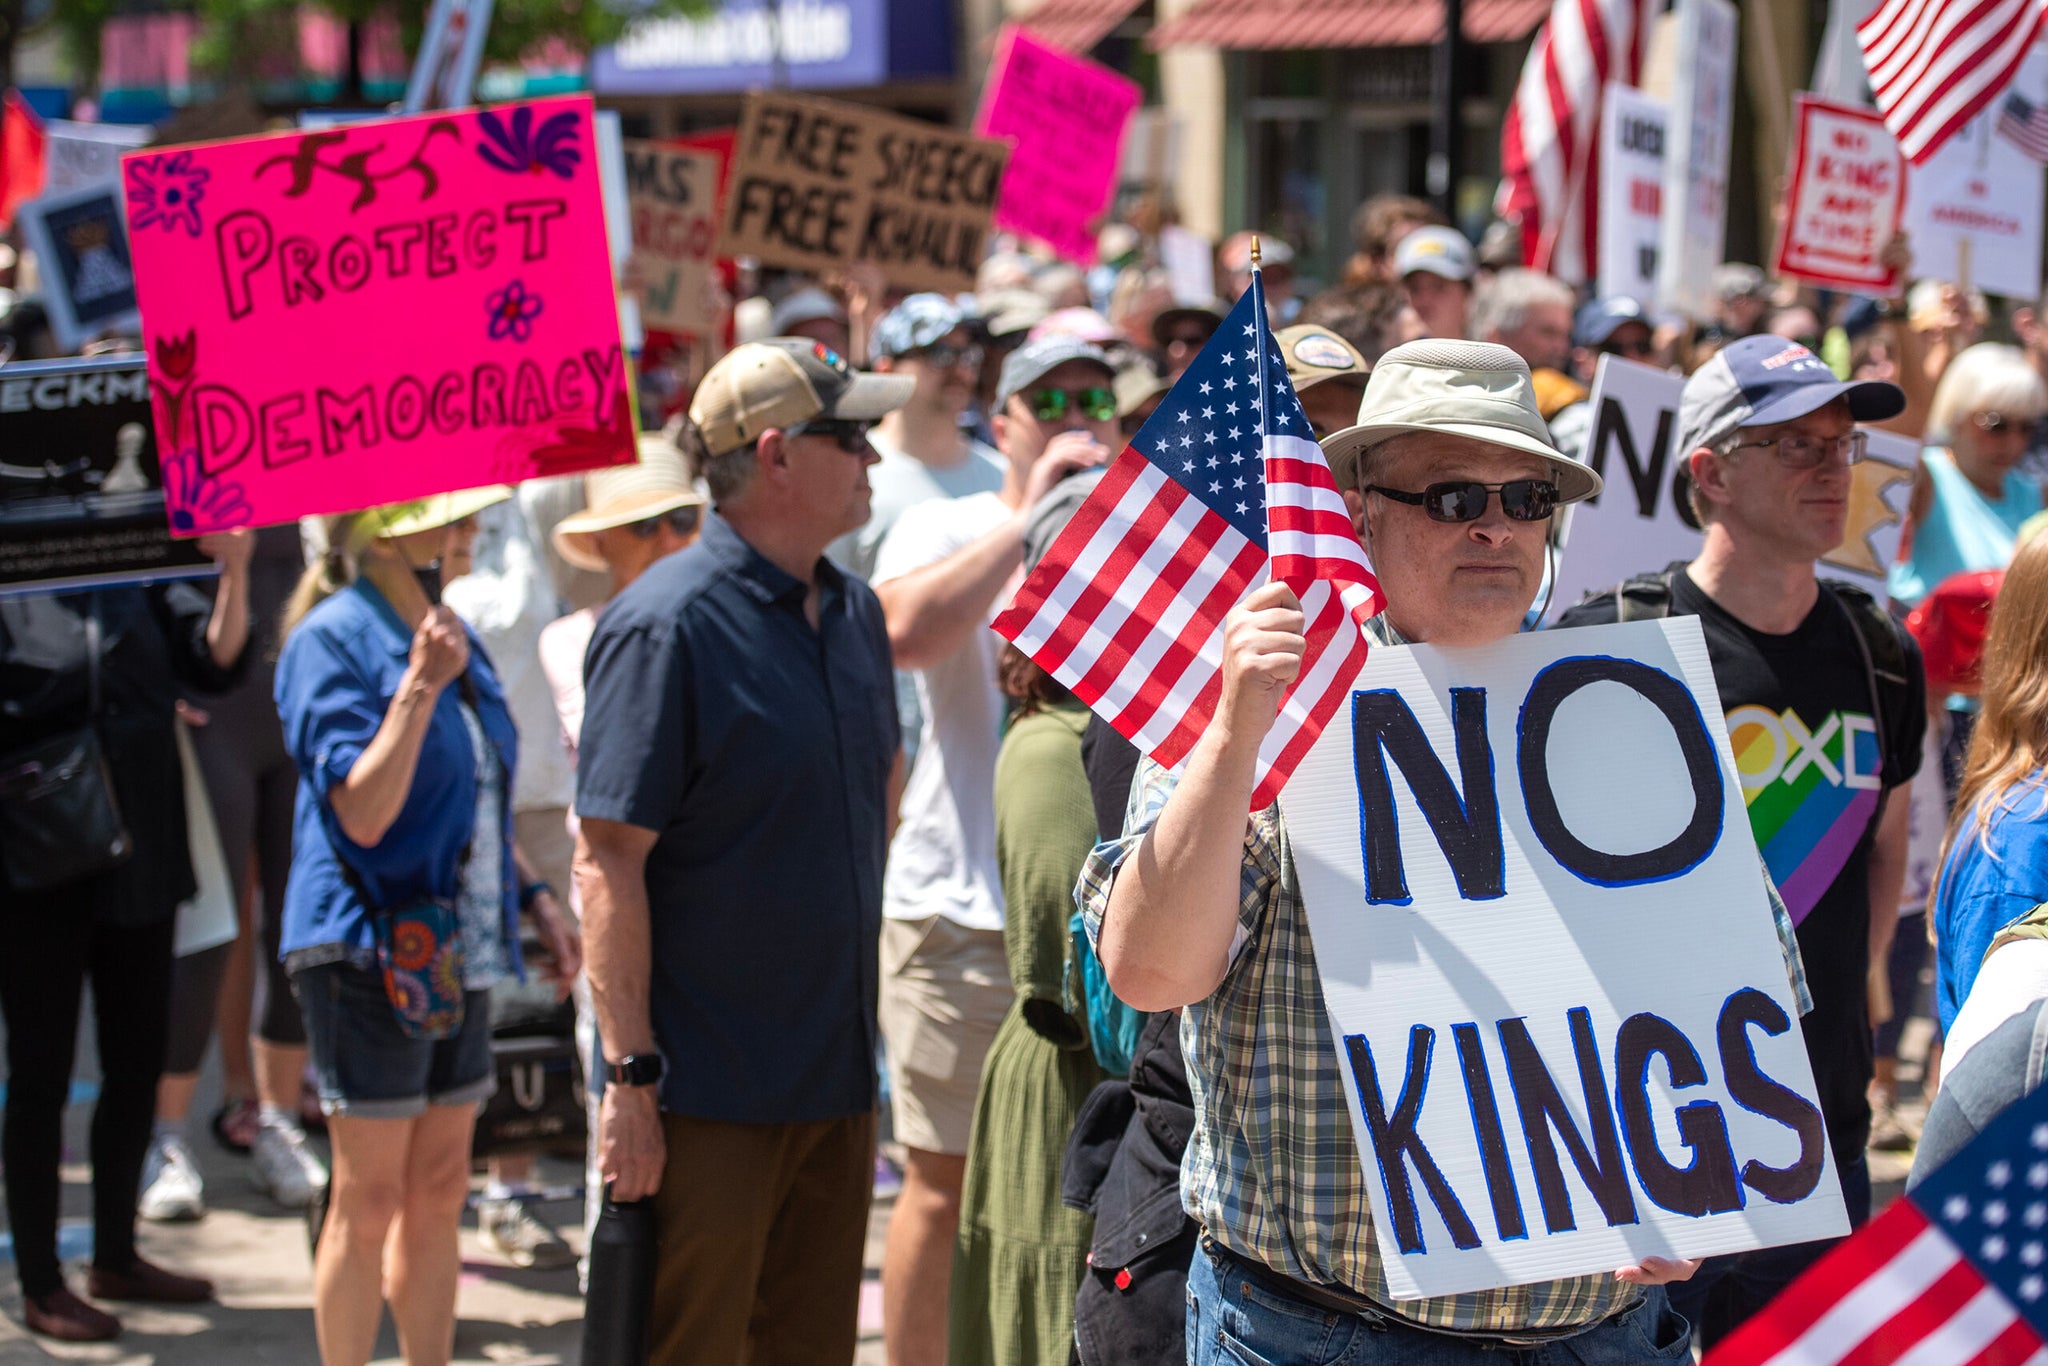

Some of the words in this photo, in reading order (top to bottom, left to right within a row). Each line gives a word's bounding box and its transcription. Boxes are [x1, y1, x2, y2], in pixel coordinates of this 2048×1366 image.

[628, 152, 693, 205] MS
[752, 104, 858, 180] FREE
[872, 130, 1003, 207] SPEECH
[1816, 154, 1890, 197] KING
[213, 198, 569, 322] PROTECT
[632, 207, 713, 263] RGO
[731, 175, 856, 257] FREE
[857, 200, 982, 277] KHALIL
[1808, 213, 1874, 245] TIME
[0, 370, 153, 412] ECKM
[191, 344, 625, 478] DEMOCRACY
[1350, 654, 1727, 907] NO
[1342, 986, 1826, 1256] KINGS
